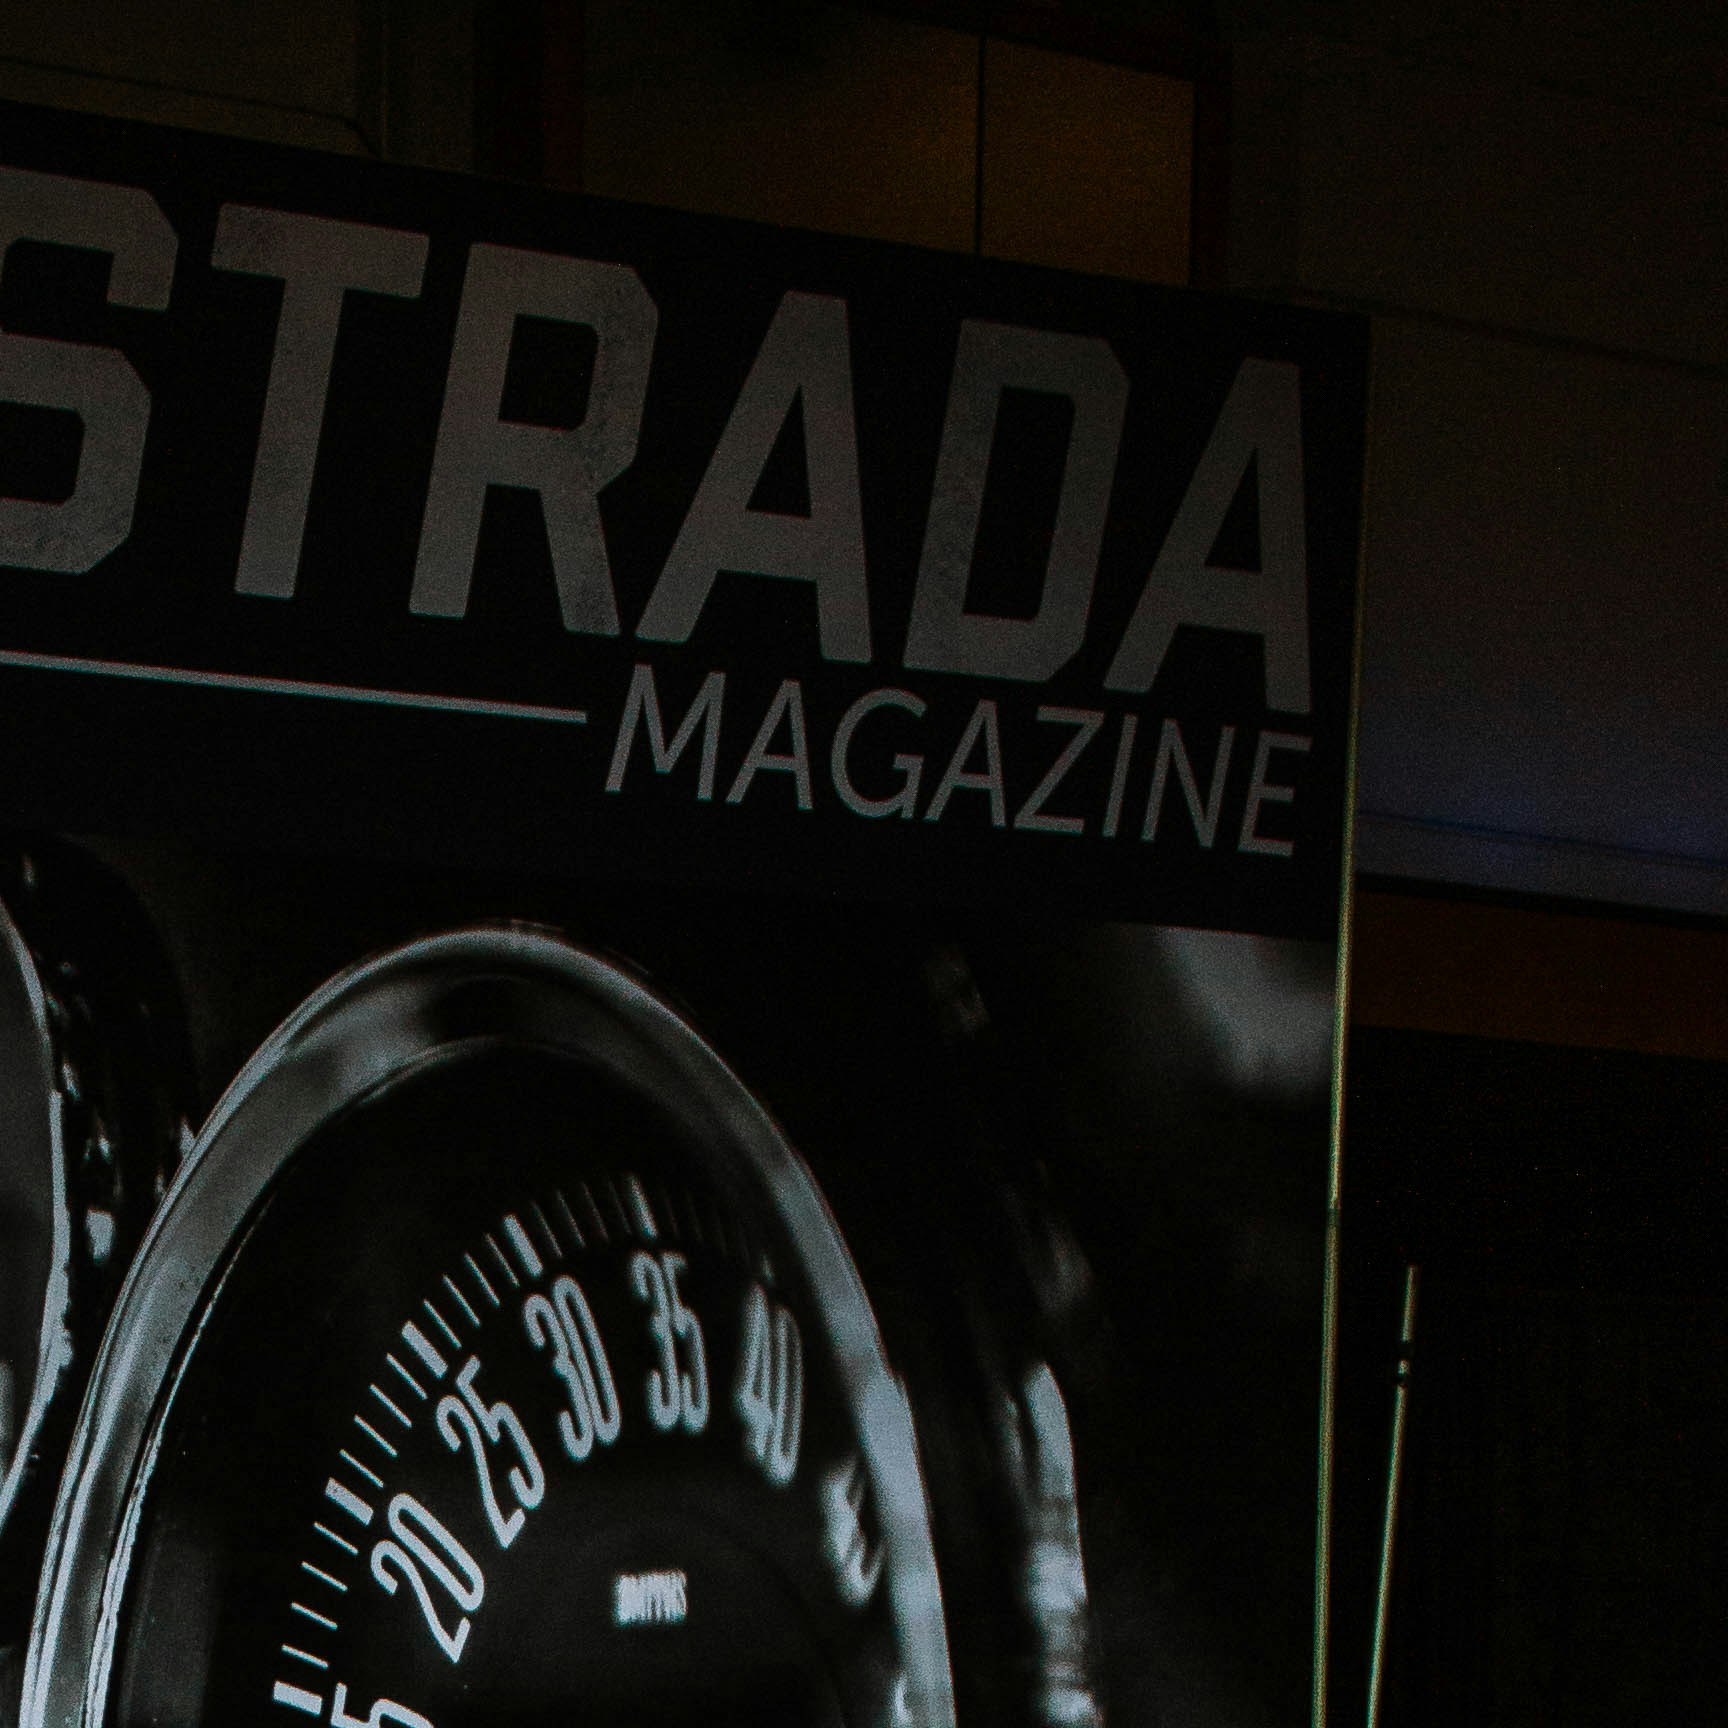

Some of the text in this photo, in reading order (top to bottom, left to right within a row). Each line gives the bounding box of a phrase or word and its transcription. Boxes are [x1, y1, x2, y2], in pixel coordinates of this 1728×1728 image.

[603, 661, 1313, 860] MAGAZINE
[520, 1274, 622, 1463] 30
[627, 1249, 710, 1434] 35
[729, 1282, 806, 1488] 40
[434, 1354, 547, 1550] 25
[369, 1492, 486, 1665] 20
